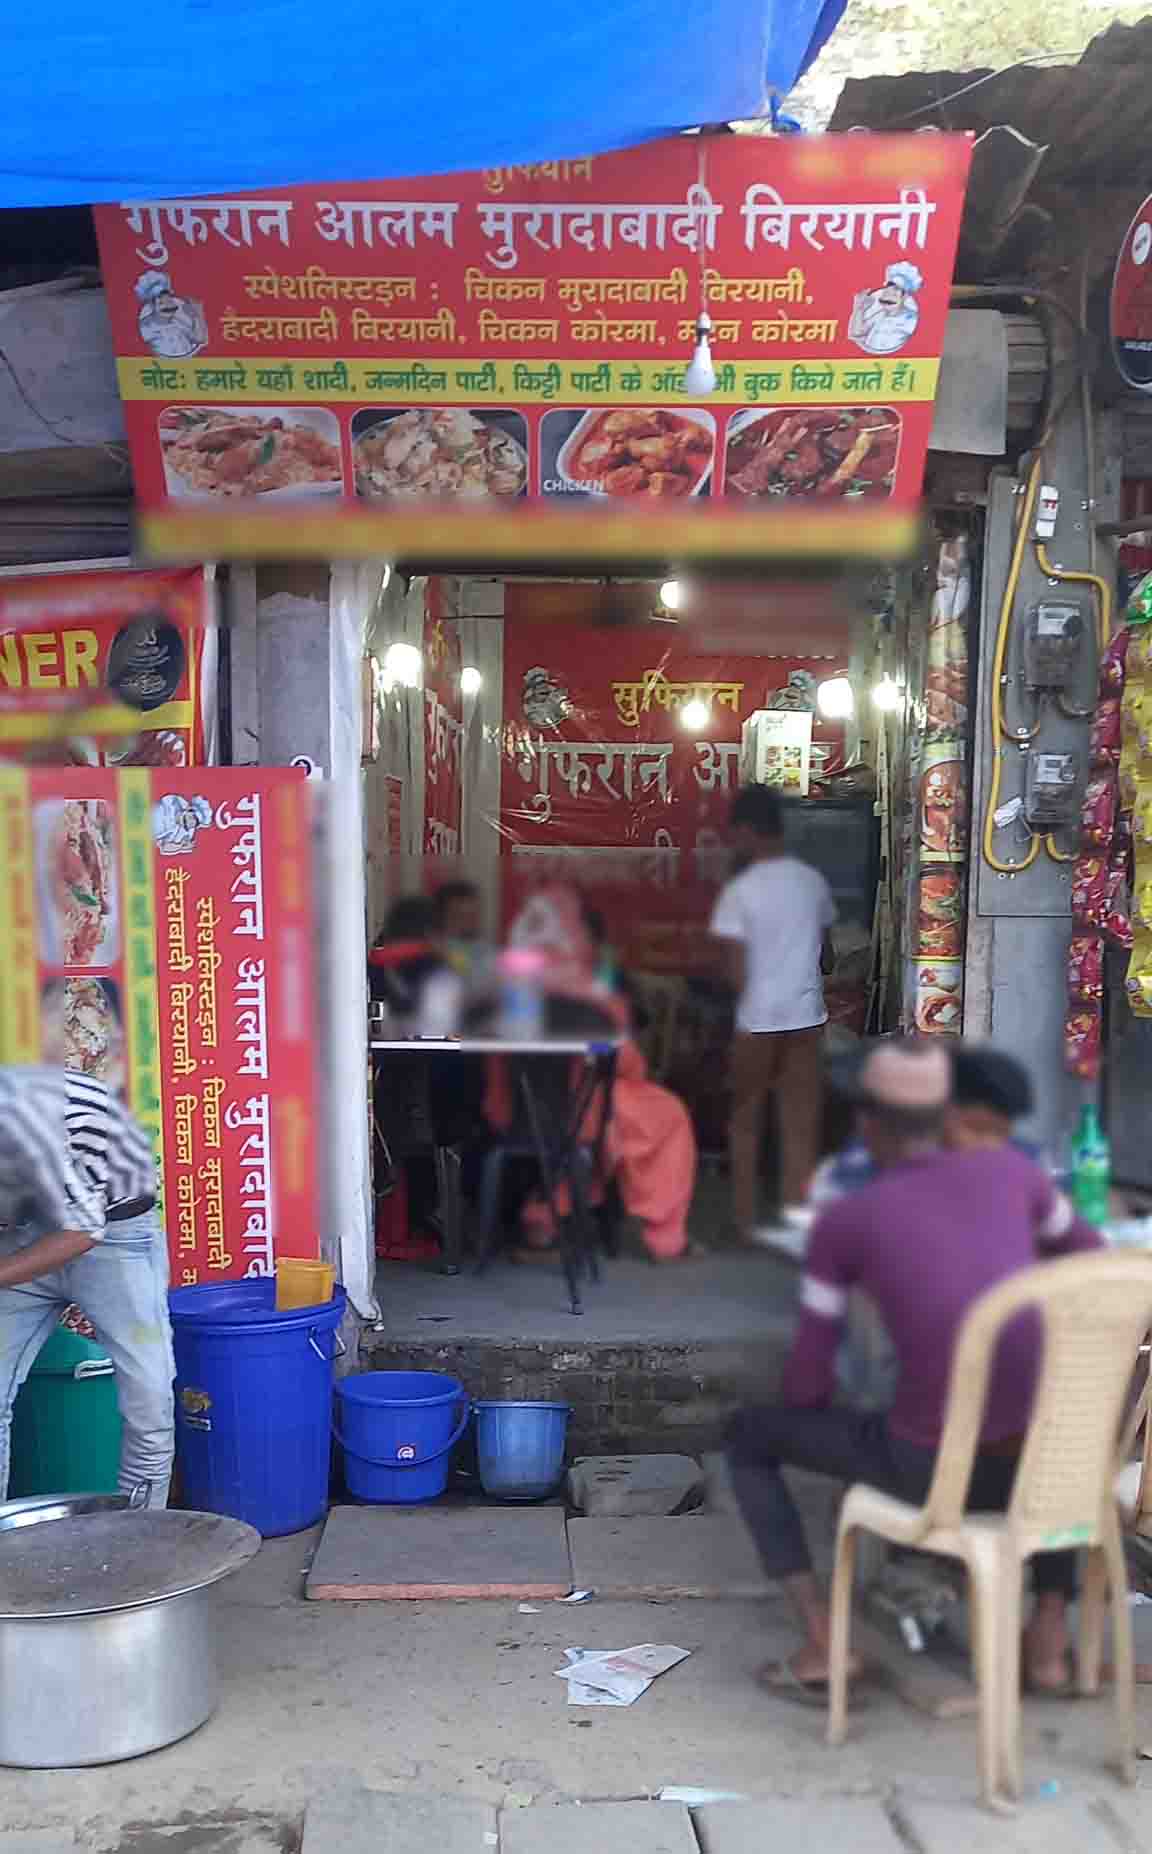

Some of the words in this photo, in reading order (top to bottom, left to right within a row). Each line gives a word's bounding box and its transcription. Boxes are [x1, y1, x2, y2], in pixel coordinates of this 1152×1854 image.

[120, 199, 293, 266] गुफरान
[315, 201, 459, 249] आलम
[477, 184, 724, 270] मुरादाबादी
[741, 183, 937, 252] बिरयानी
[463, 268, 545, 303] चिकन
[558, 267, 689, 312] मुरादाबादी
[479, 310, 560, 344] चिकन
[752, 309, 839, 345] कोरमा
[195, 362, 249, 390] हमारे
[364, 362, 447, 392] जन्मदिन
[620, 364, 642, 393] के
[745, 370, 782, 401] बुक
[790, 363, 833, 393] किये
[843, 362, 883, 392] जाते
[215, 792, 264, 941] गुफरान
[165, 866, 194, 972] हैदराबादी
[233, 957, 268, 1079] आलम
[173, 1094, 198, 1166] चिकन
[202, 1076, 226, 1148] चिकन
[197, 1157, 233, 1270] मुरादाबादी
